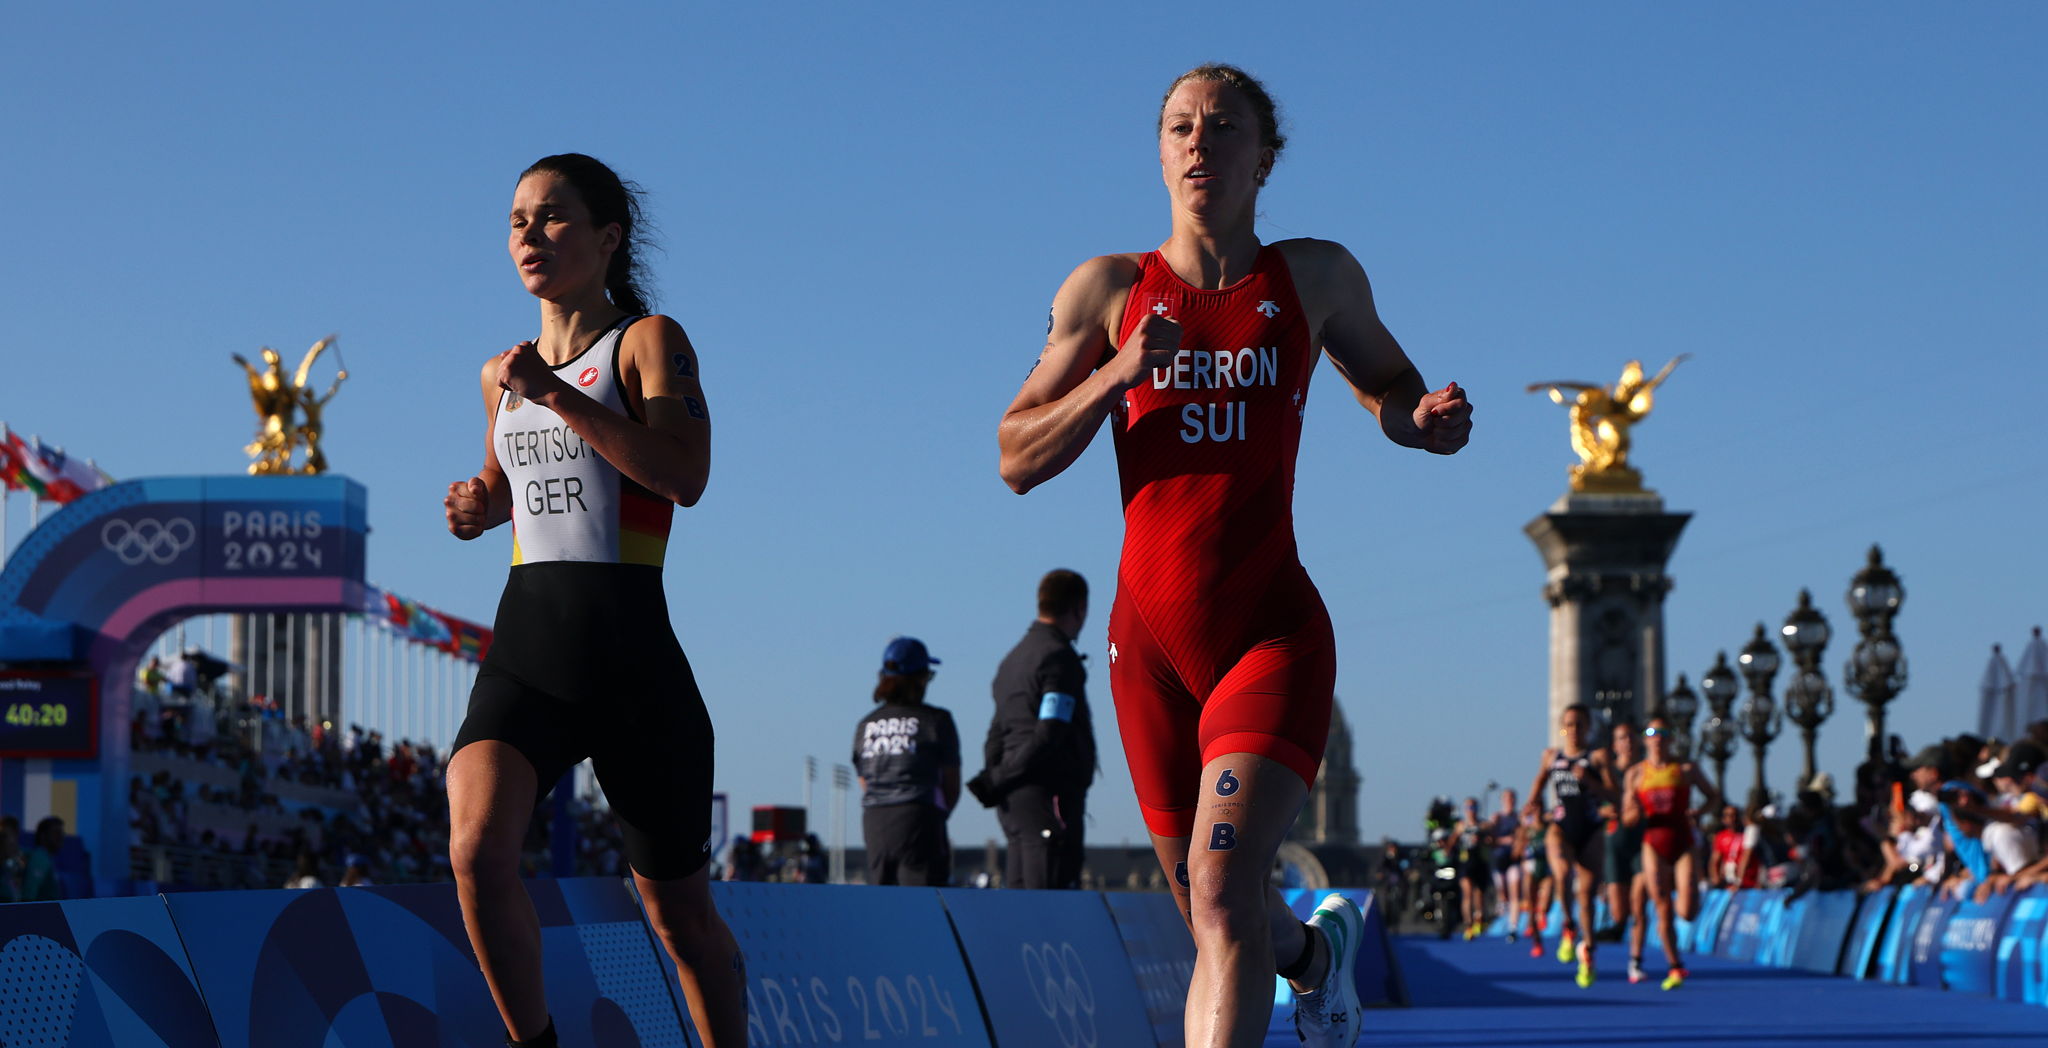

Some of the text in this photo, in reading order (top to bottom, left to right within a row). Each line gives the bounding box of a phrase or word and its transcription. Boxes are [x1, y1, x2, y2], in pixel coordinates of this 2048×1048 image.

[672, 352, 695, 378] 2
[1152, 346, 1278, 390] DERRON
[681, 394, 708, 420] B
[1180, 401, 1246, 444] SUI
[525, 476, 588, 516] GER
[223, 541, 323, 570] 2024
[5, 703, 67, 727] 40:20
[861, 734, 917, 759] 2024
[1215, 769, 1240, 797] 6
[1208, 822, 1237, 851] B
[747, 975, 962, 1046] ARIS 2024
